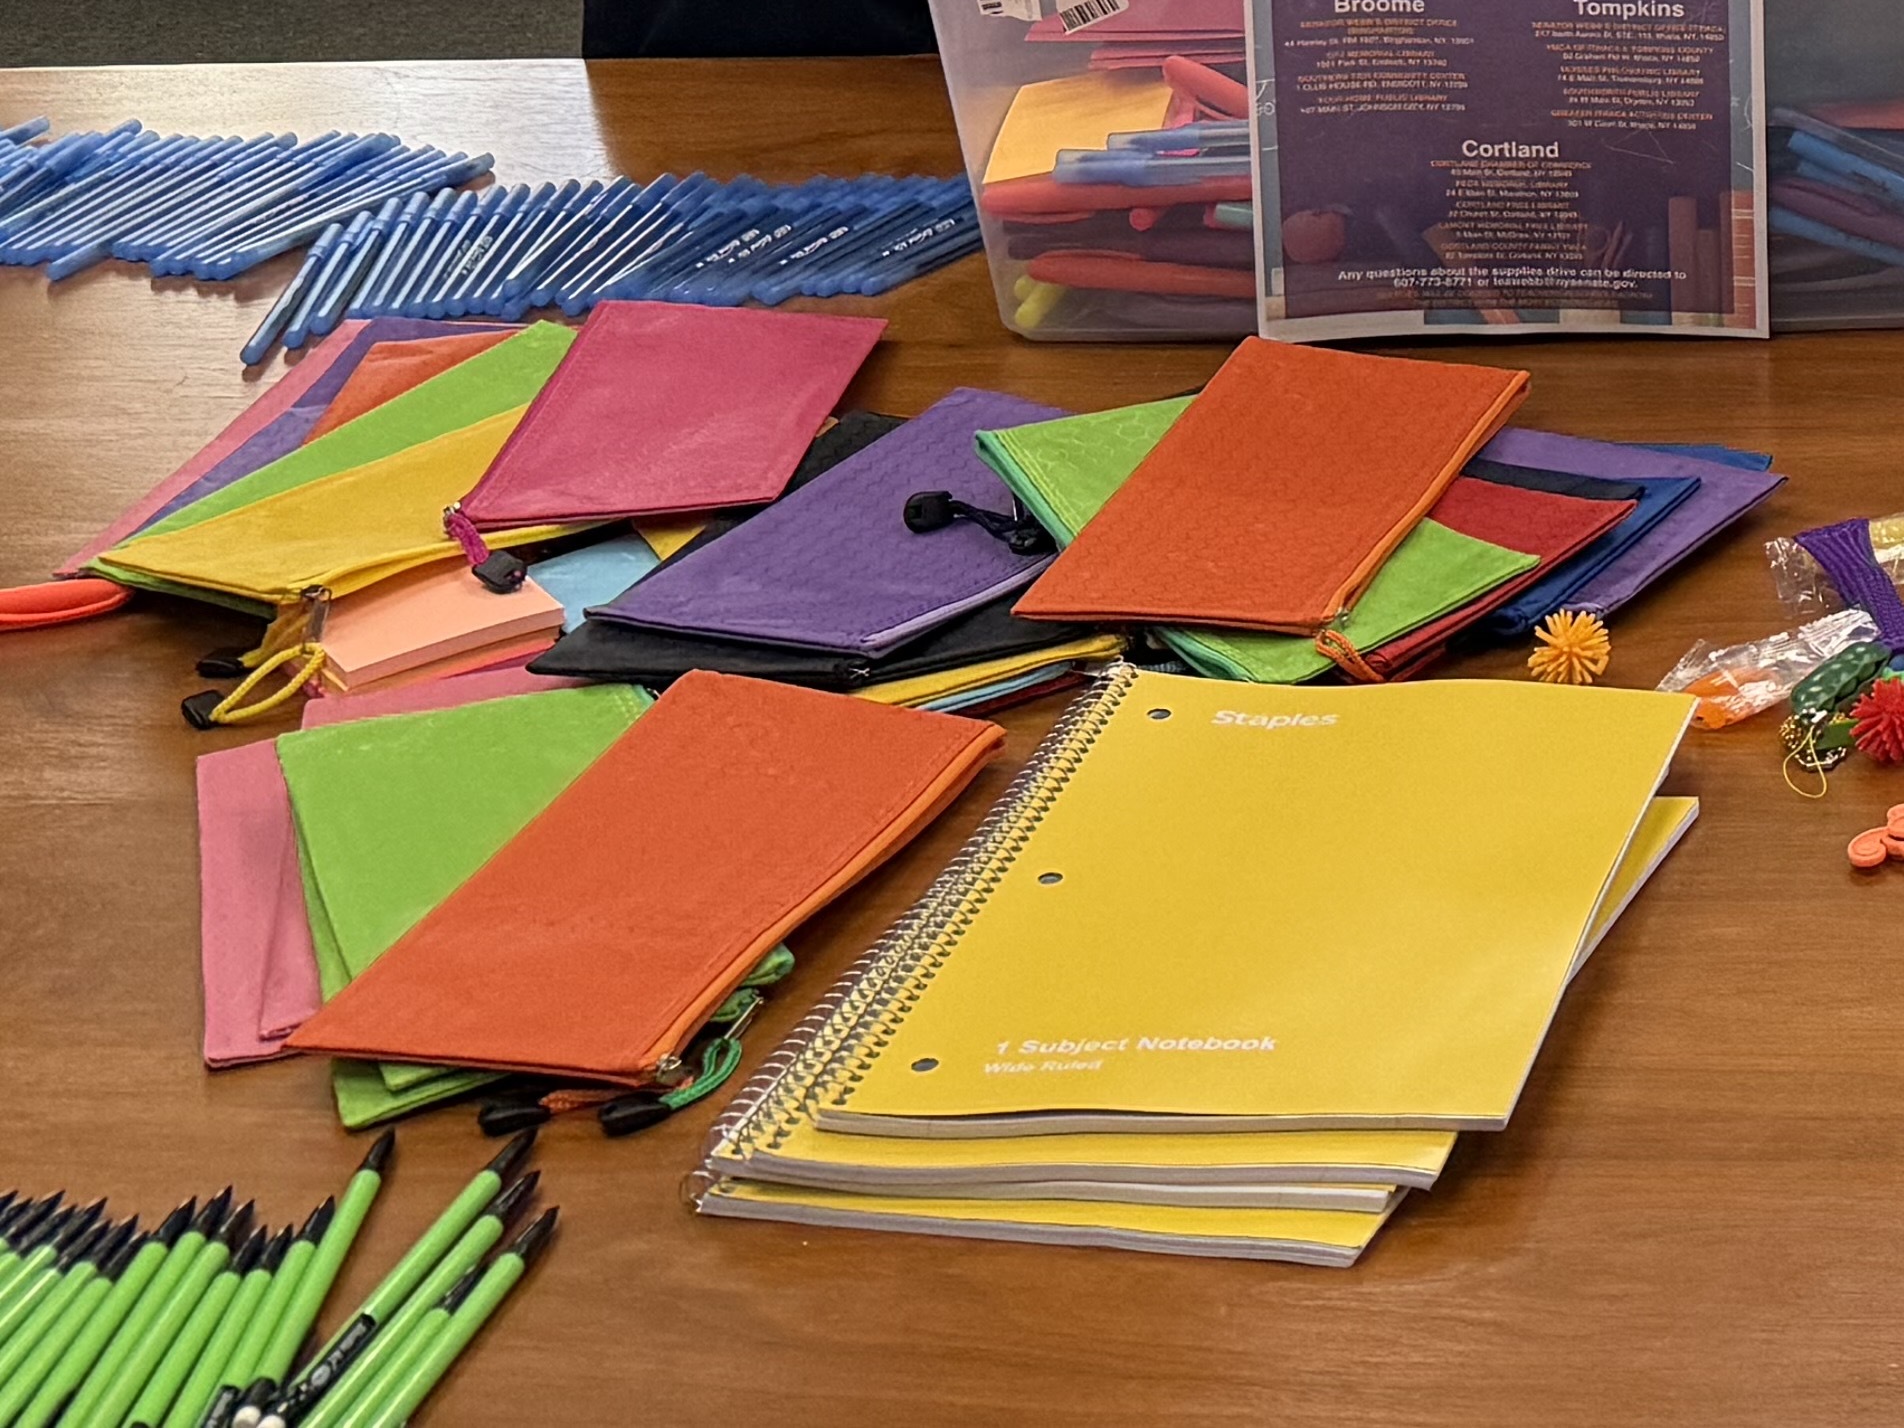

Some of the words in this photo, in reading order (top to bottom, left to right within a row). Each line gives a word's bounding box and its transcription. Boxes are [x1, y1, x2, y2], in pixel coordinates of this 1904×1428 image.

[1462, 139, 1560, 159] Cortland
[1210, 709, 1339, 731] Staples
[996, 1039, 1009, 1055] 1
[1016, 1035, 1129, 1059] Subject
[1135, 1034, 1277, 1053] Notebook
[983, 1059, 1036, 1076] Wide
[1040, 1057, 1103, 1074] Ruled
